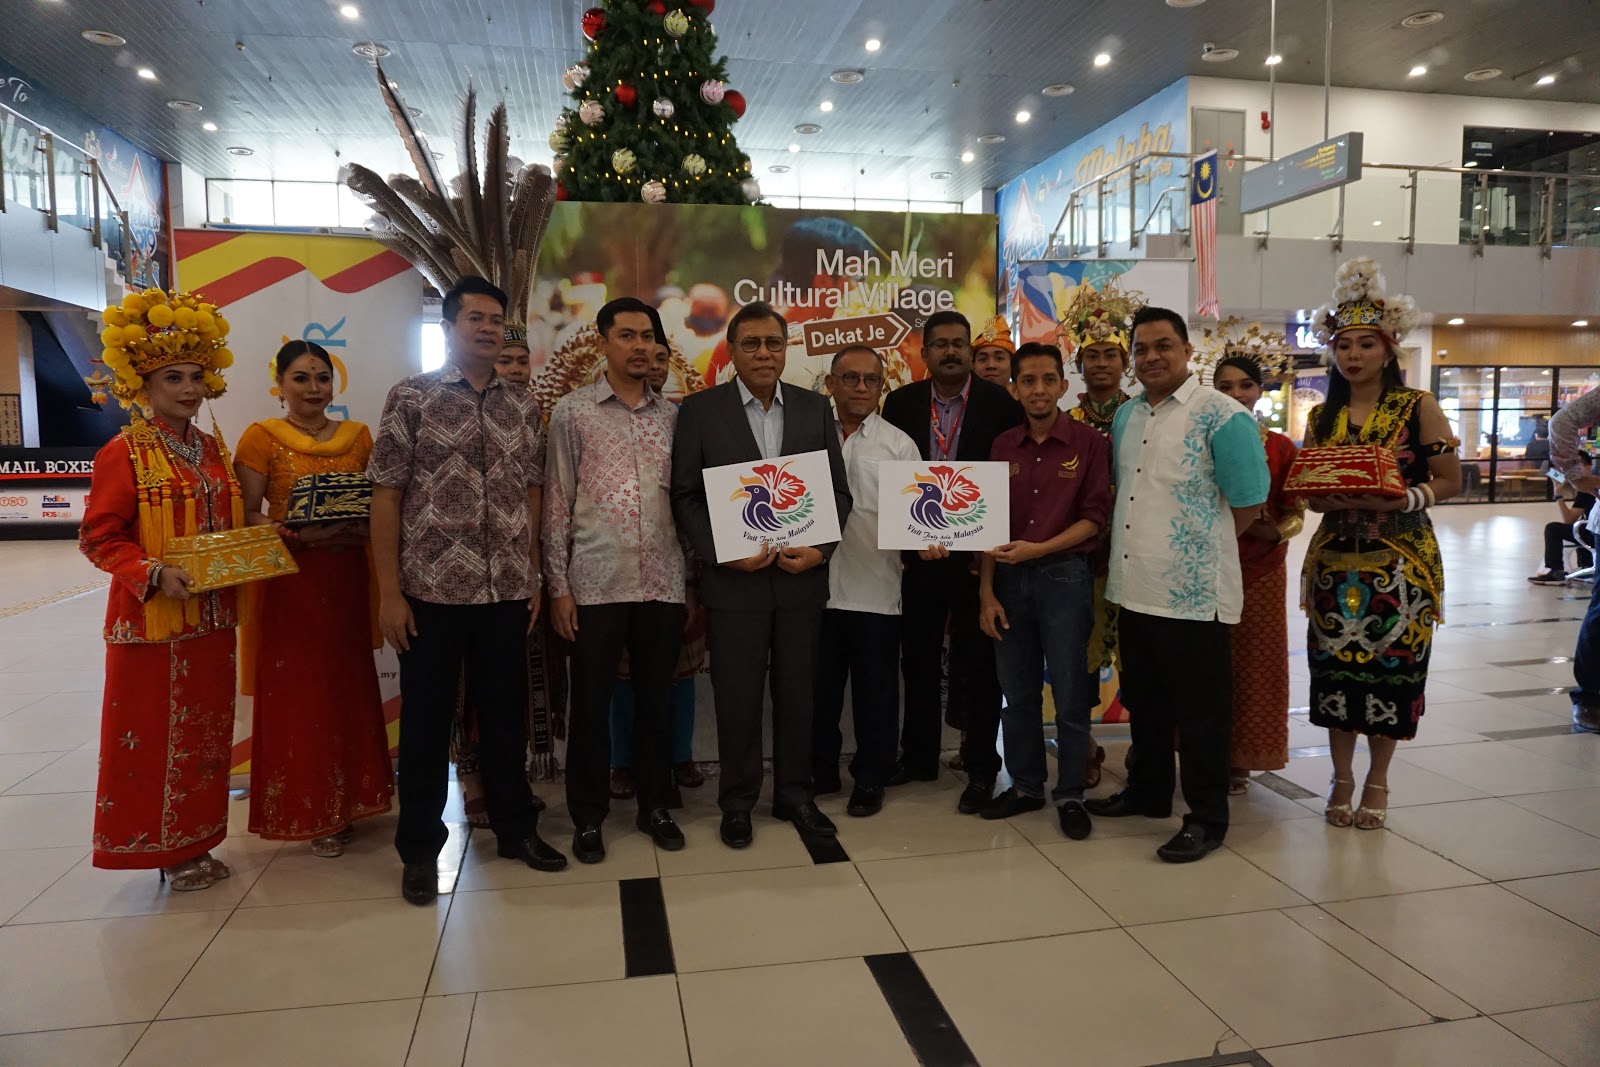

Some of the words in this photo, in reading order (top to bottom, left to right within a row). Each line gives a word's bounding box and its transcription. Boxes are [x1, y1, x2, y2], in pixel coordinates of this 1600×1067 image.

[8, 77, 34, 102] To
[816, 249, 881, 277] Mah
[891, 251, 953, 278] Meri
[733, 279, 849, 309] Cultural
[856, 281, 954, 316] Village
[810, 328, 863, 348] Dekat
[867, 324, 886, 341] Je
[0, 461, 40, 474] MAIL
[43, 495, 66, 503] FedEx
[742, 530, 758, 542] Visit
[787, 518, 816, 539] Malaysia
[907, 524, 922, 536] Visit
[953, 524, 985, 539] Malaysia
